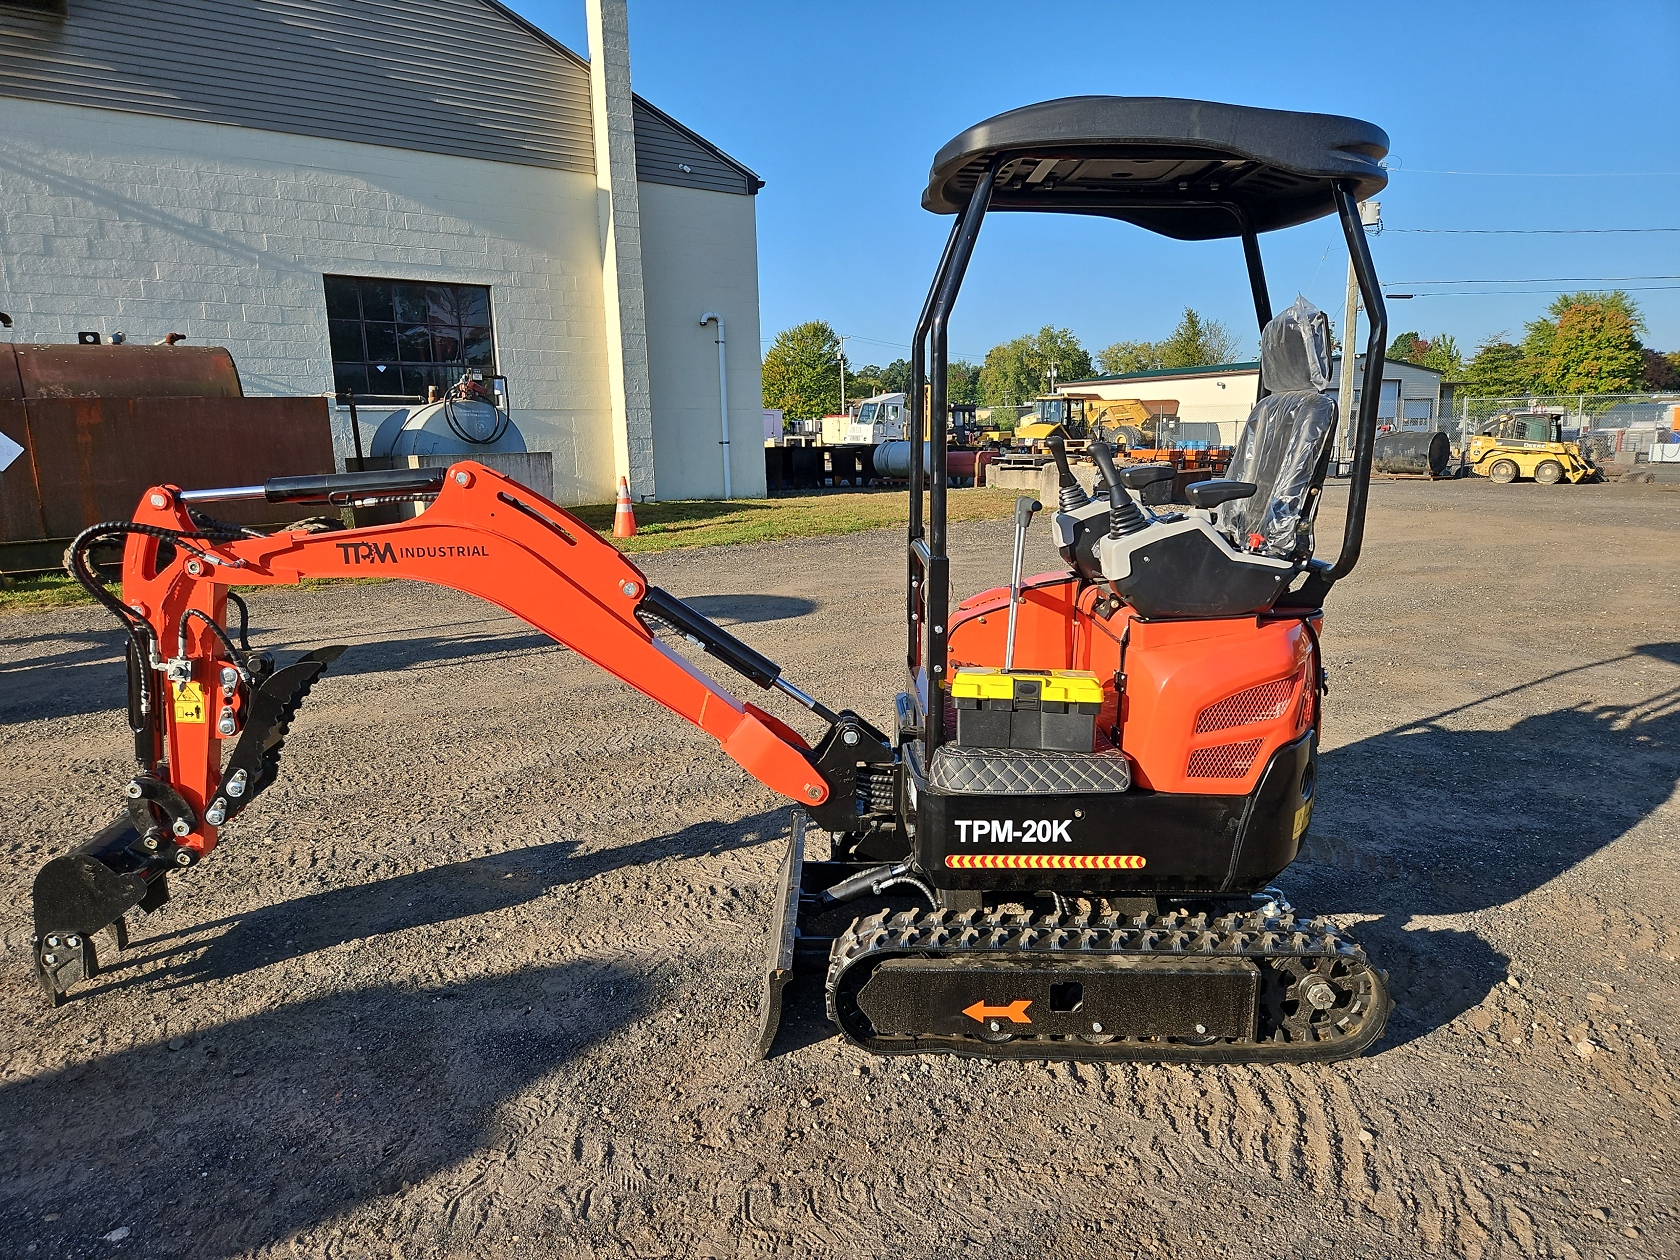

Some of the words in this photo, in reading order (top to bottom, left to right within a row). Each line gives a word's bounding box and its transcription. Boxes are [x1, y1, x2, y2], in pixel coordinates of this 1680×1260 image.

[336, 541, 398, 564] TPM
[400, 546, 489, 558] INDUSTRIAL
[954, 820, 1073, 843] TPM-20K
